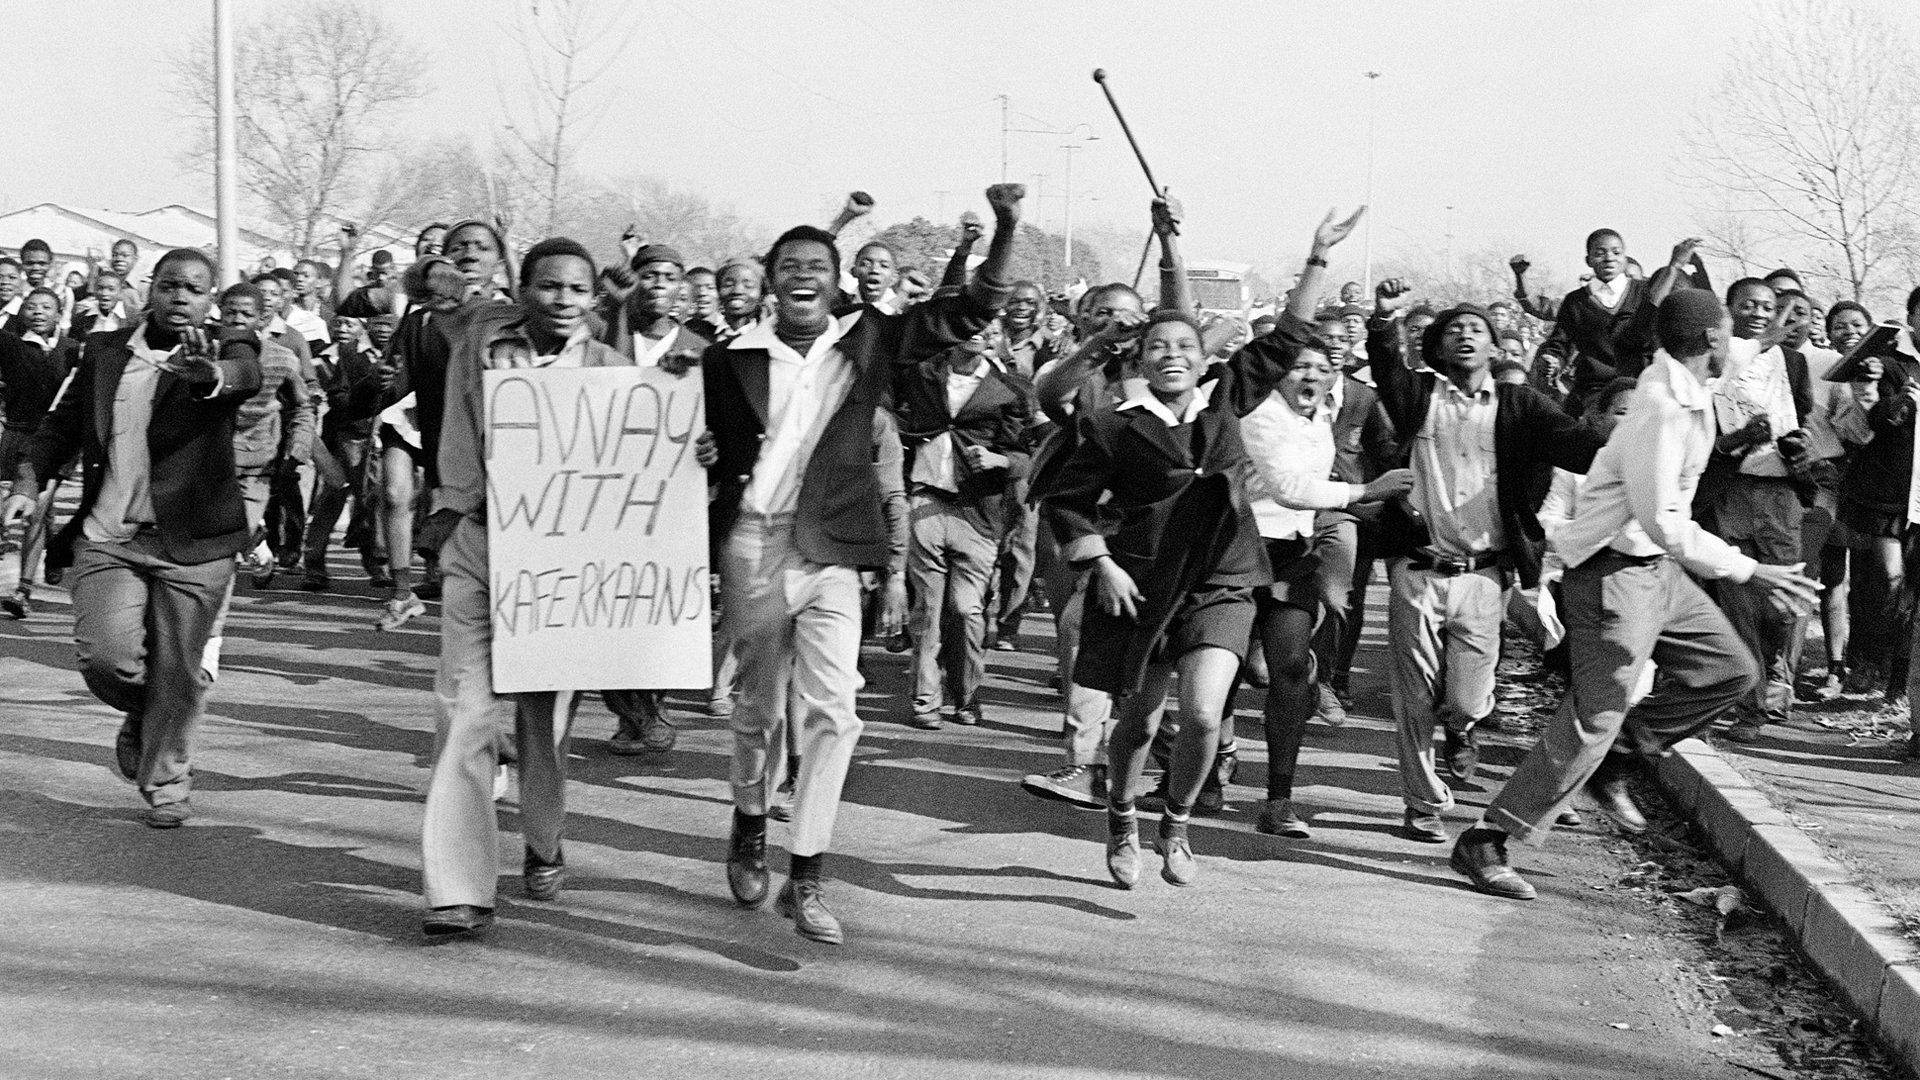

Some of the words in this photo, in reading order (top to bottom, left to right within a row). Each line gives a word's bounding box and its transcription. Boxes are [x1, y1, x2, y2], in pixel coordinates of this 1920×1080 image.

[488, 376, 701, 478] AWAY
[487, 469, 667, 536] WITH
[496, 560, 707, 637] KAFERKAANS
